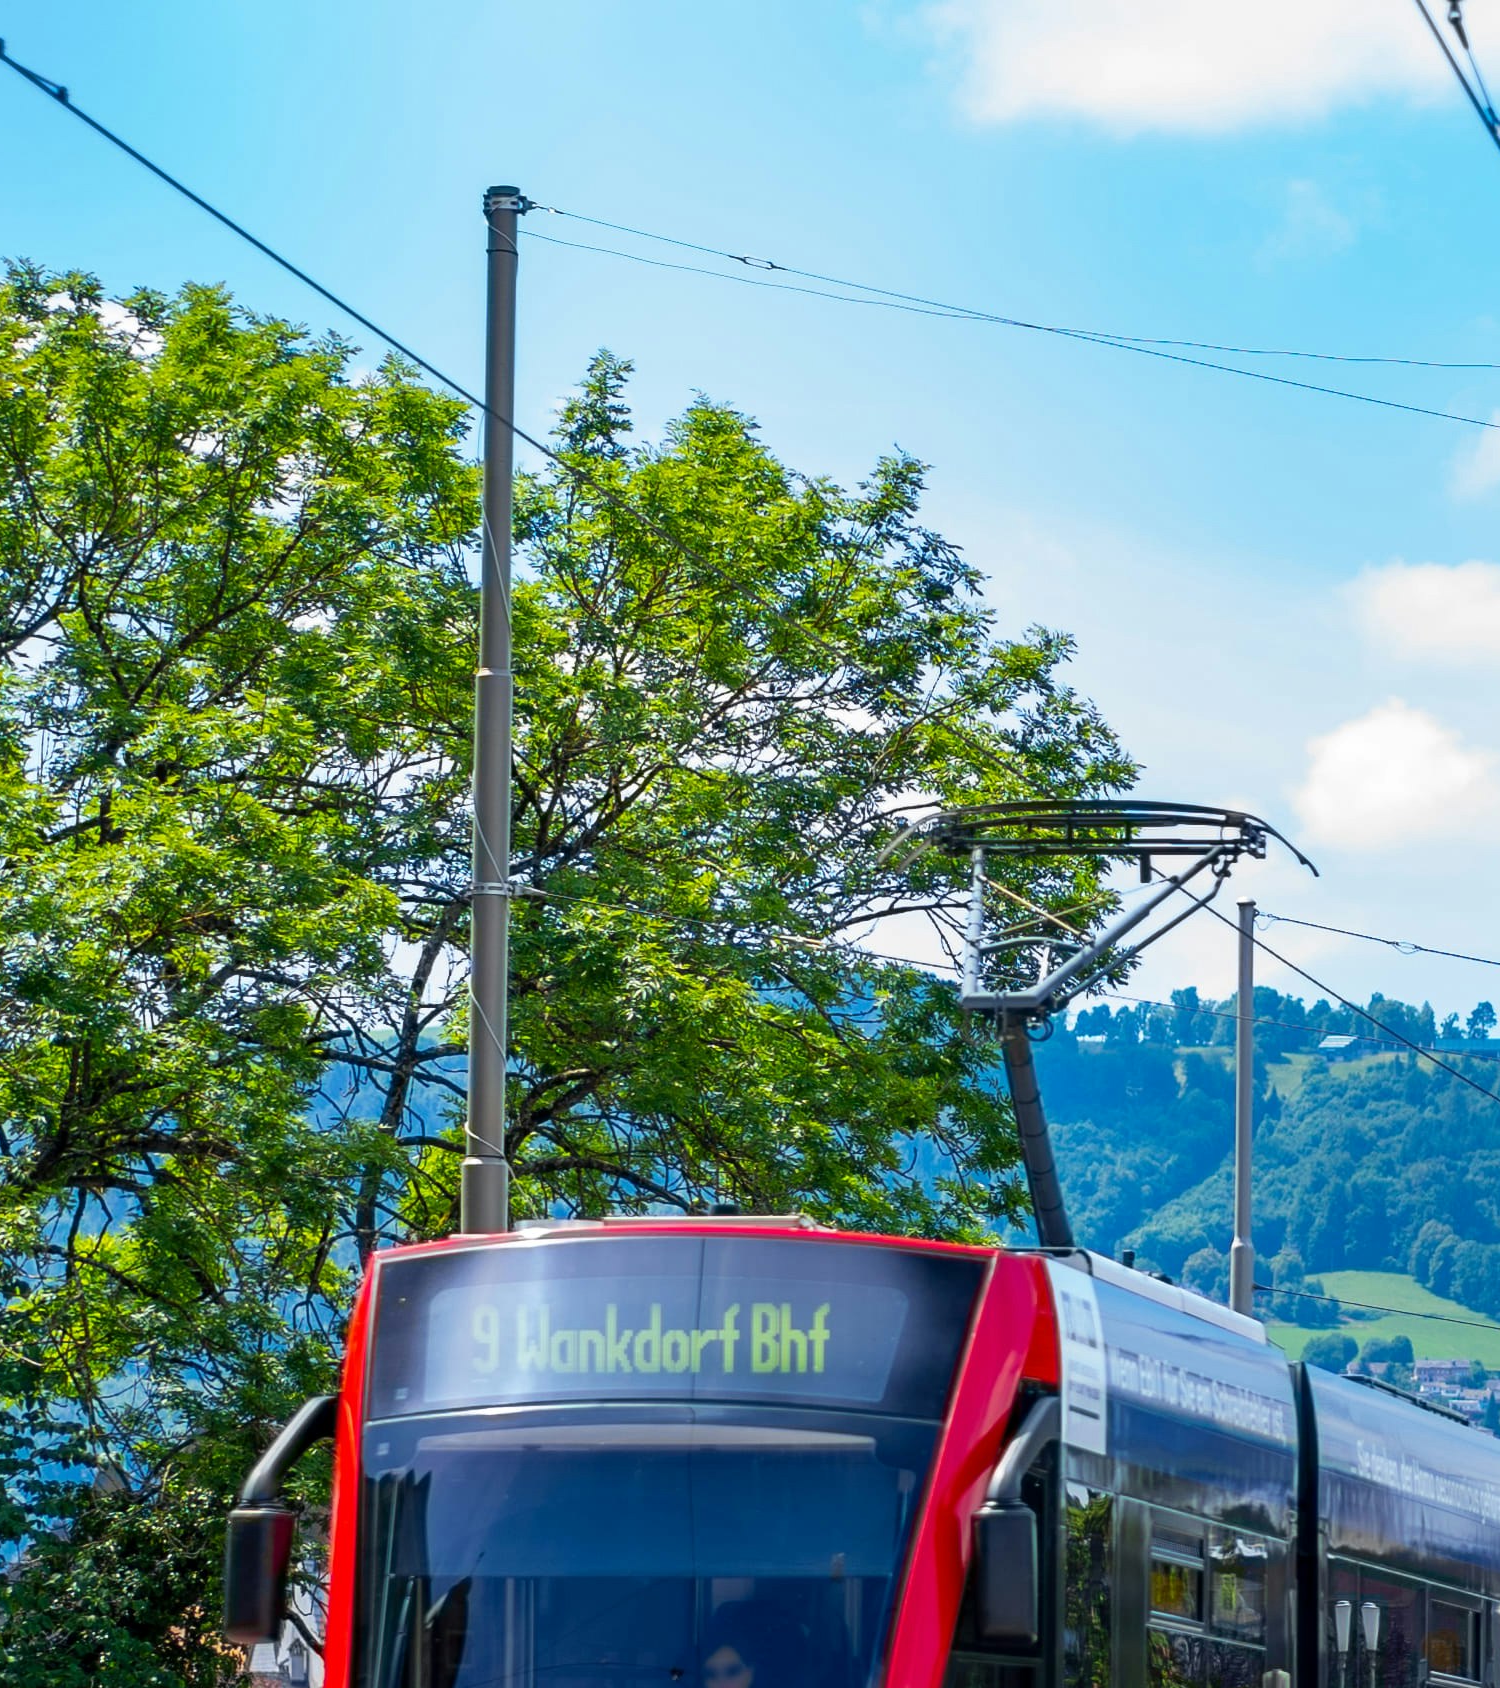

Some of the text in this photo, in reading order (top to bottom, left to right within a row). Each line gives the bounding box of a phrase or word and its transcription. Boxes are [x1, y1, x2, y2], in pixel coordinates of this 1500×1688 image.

[472, 1303, 831, 1374] 9 Wankdorf Bhf
